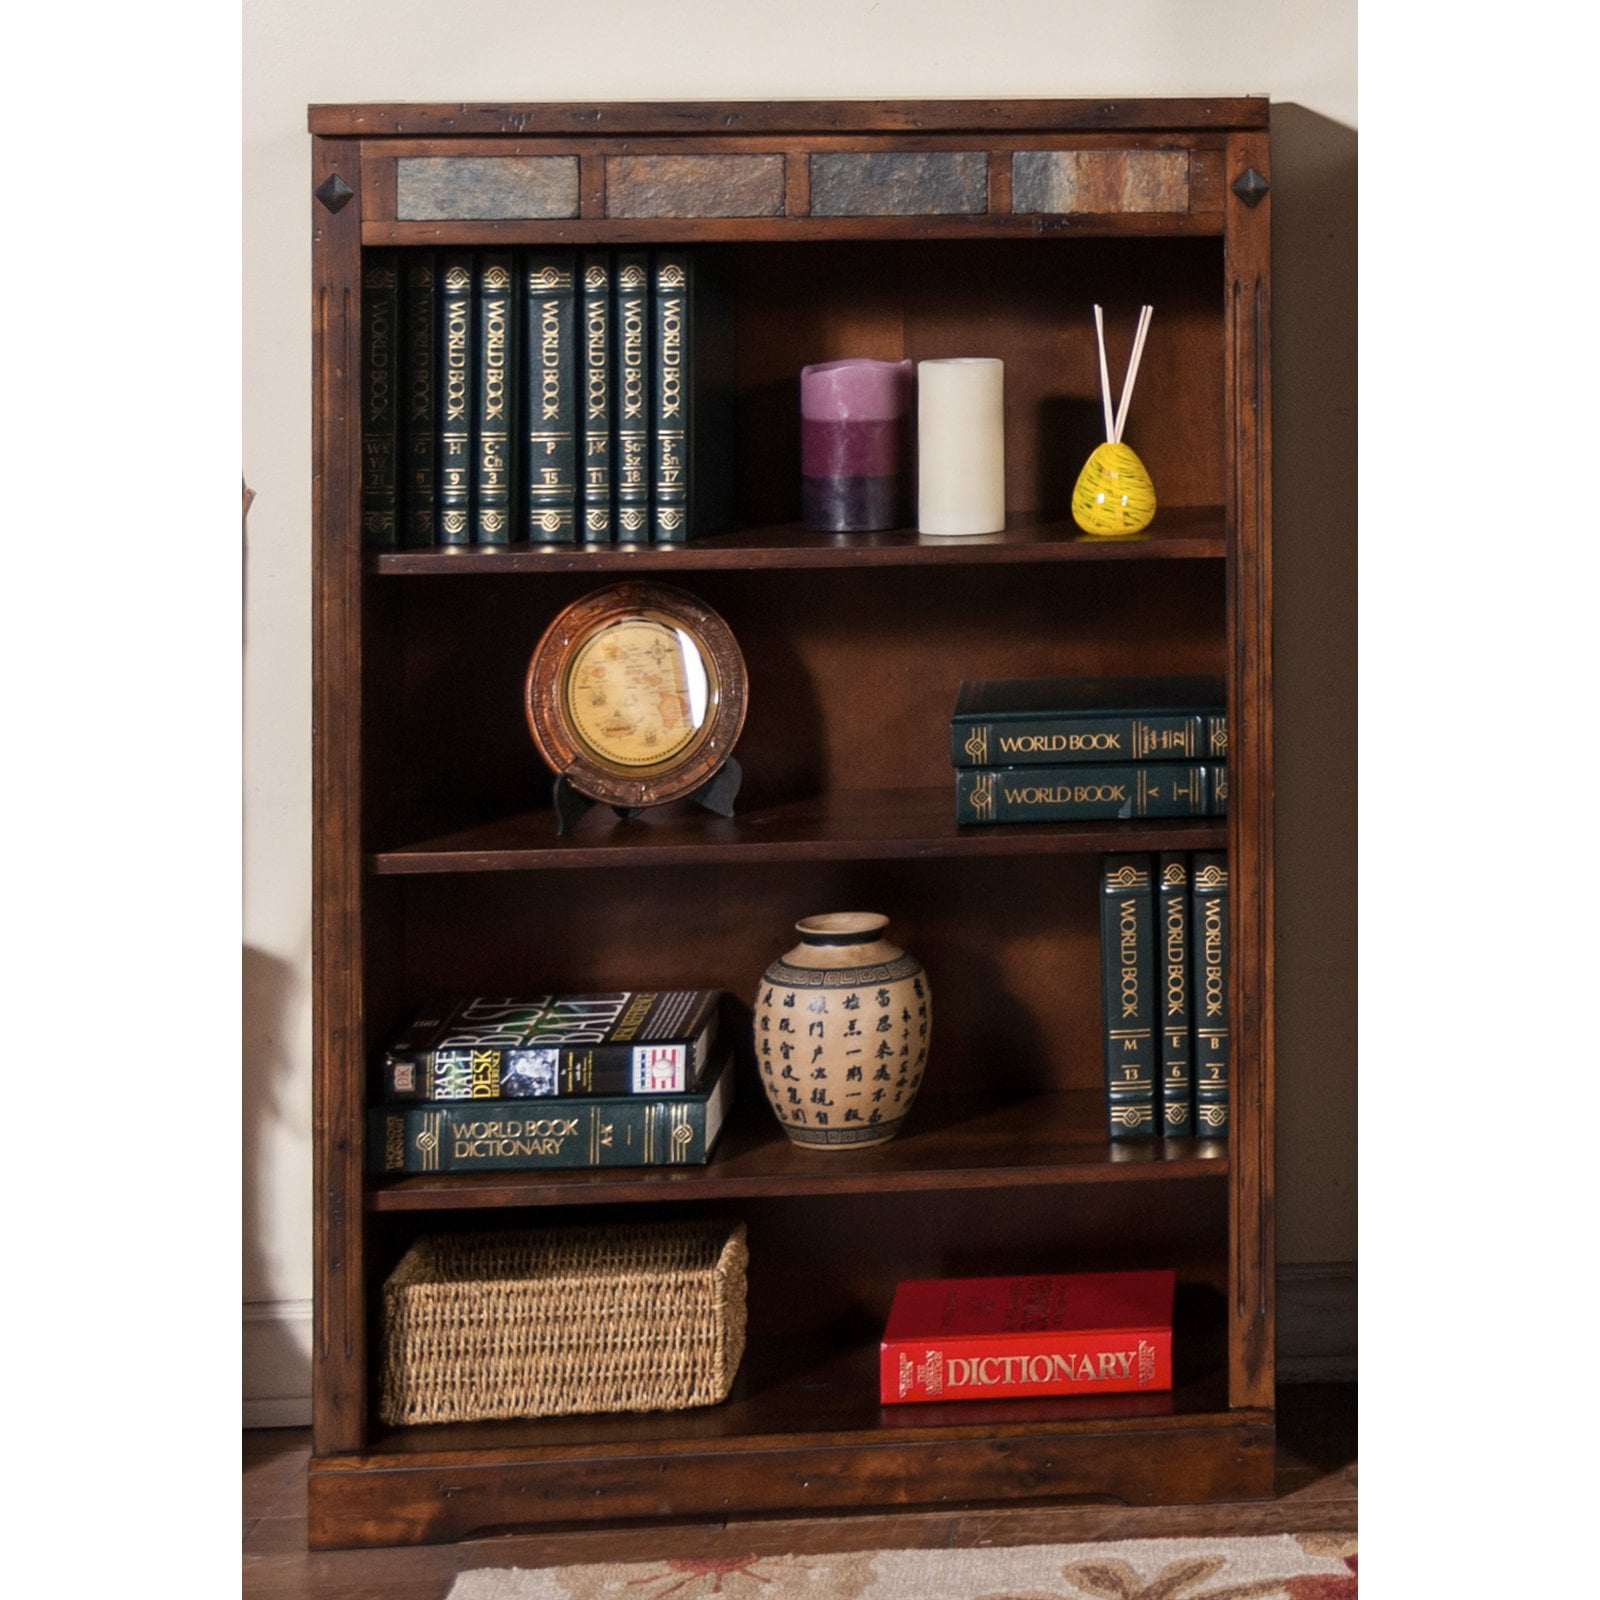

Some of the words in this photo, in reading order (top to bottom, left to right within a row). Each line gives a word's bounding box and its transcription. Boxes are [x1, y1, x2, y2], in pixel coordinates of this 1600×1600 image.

[448, 301, 466, 367] WORLD
[486, 300, 505, 367] WORLD
[542, 300, 560, 367] WORLD
[588, 300, 606, 367] WORLD
[623, 299, 642, 366] WORLD
[663, 299, 681, 366] WORLD
[447, 369, 466, 420] BOOK
[485, 368, 504, 420] BOOK
[542, 368, 560, 420] BOOK
[588, 368, 606, 419] BOOK
[624, 368, 642, 419] BOOK
[662, 368, 681, 419] BOOK
[449, 442, 461, 455] H
[483, 454, 504, 468] Ch
[546, 441, 556, 455] P
[625, 453, 641, 466] Sz
[662, 453, 680, 466] Sn
[450, 472, 460, 485] 9
[488, 472, 497, 484] 3
[543, 472, 558, 484] 15
[590, 471, 603, 483] 11
[625, 470, 641, 482] 18
[663, 470, 679, 482] 17
[1000, 735, 1067, 752] WORLD
[1069, 733, 1121, 750] BOOK
[1005, 785, 1071, 804] WORLD
[1074, 784, 1126, 802] BOOK
[1147, 786, 1159, 797] A
[1120, 899, 1137, 965] WORLD
[1167, 897, 1184, 963] WORLD
[1205, 898, 1221, 964] WORLD
[1121, 967, 1138, 1018] BOOK
[1167, 965, 1185, 1016] BOOK
[1206, 966, 1222, 1017] BOOK
[438, 995, 553, 1050] BASE
[527, 992, 632, 1047] BALL
[1124, 1039, 1138, 1050] M
[1172, 1036, 1181, 1048] E
[1210, 1038, 1219, 1049] B
[435, 1050, 456, 1101] BASE
[455, 1050, 473, 1100] BALL
[473, 1049, 492, 1099] DESK
[1124, 1068, 1139, 1080] 13
[1172, 1066, 1181, 1077] 6
[1211, 1068, 1220, 1079] 2
[452, 1120, 522, 1140] WORLD
[525, 1118, 579, 1138] BOOK
[454, 1137, 565, 1159] DICTIONARY
[946, 1351, 1137, 1388] DICTIONARY
